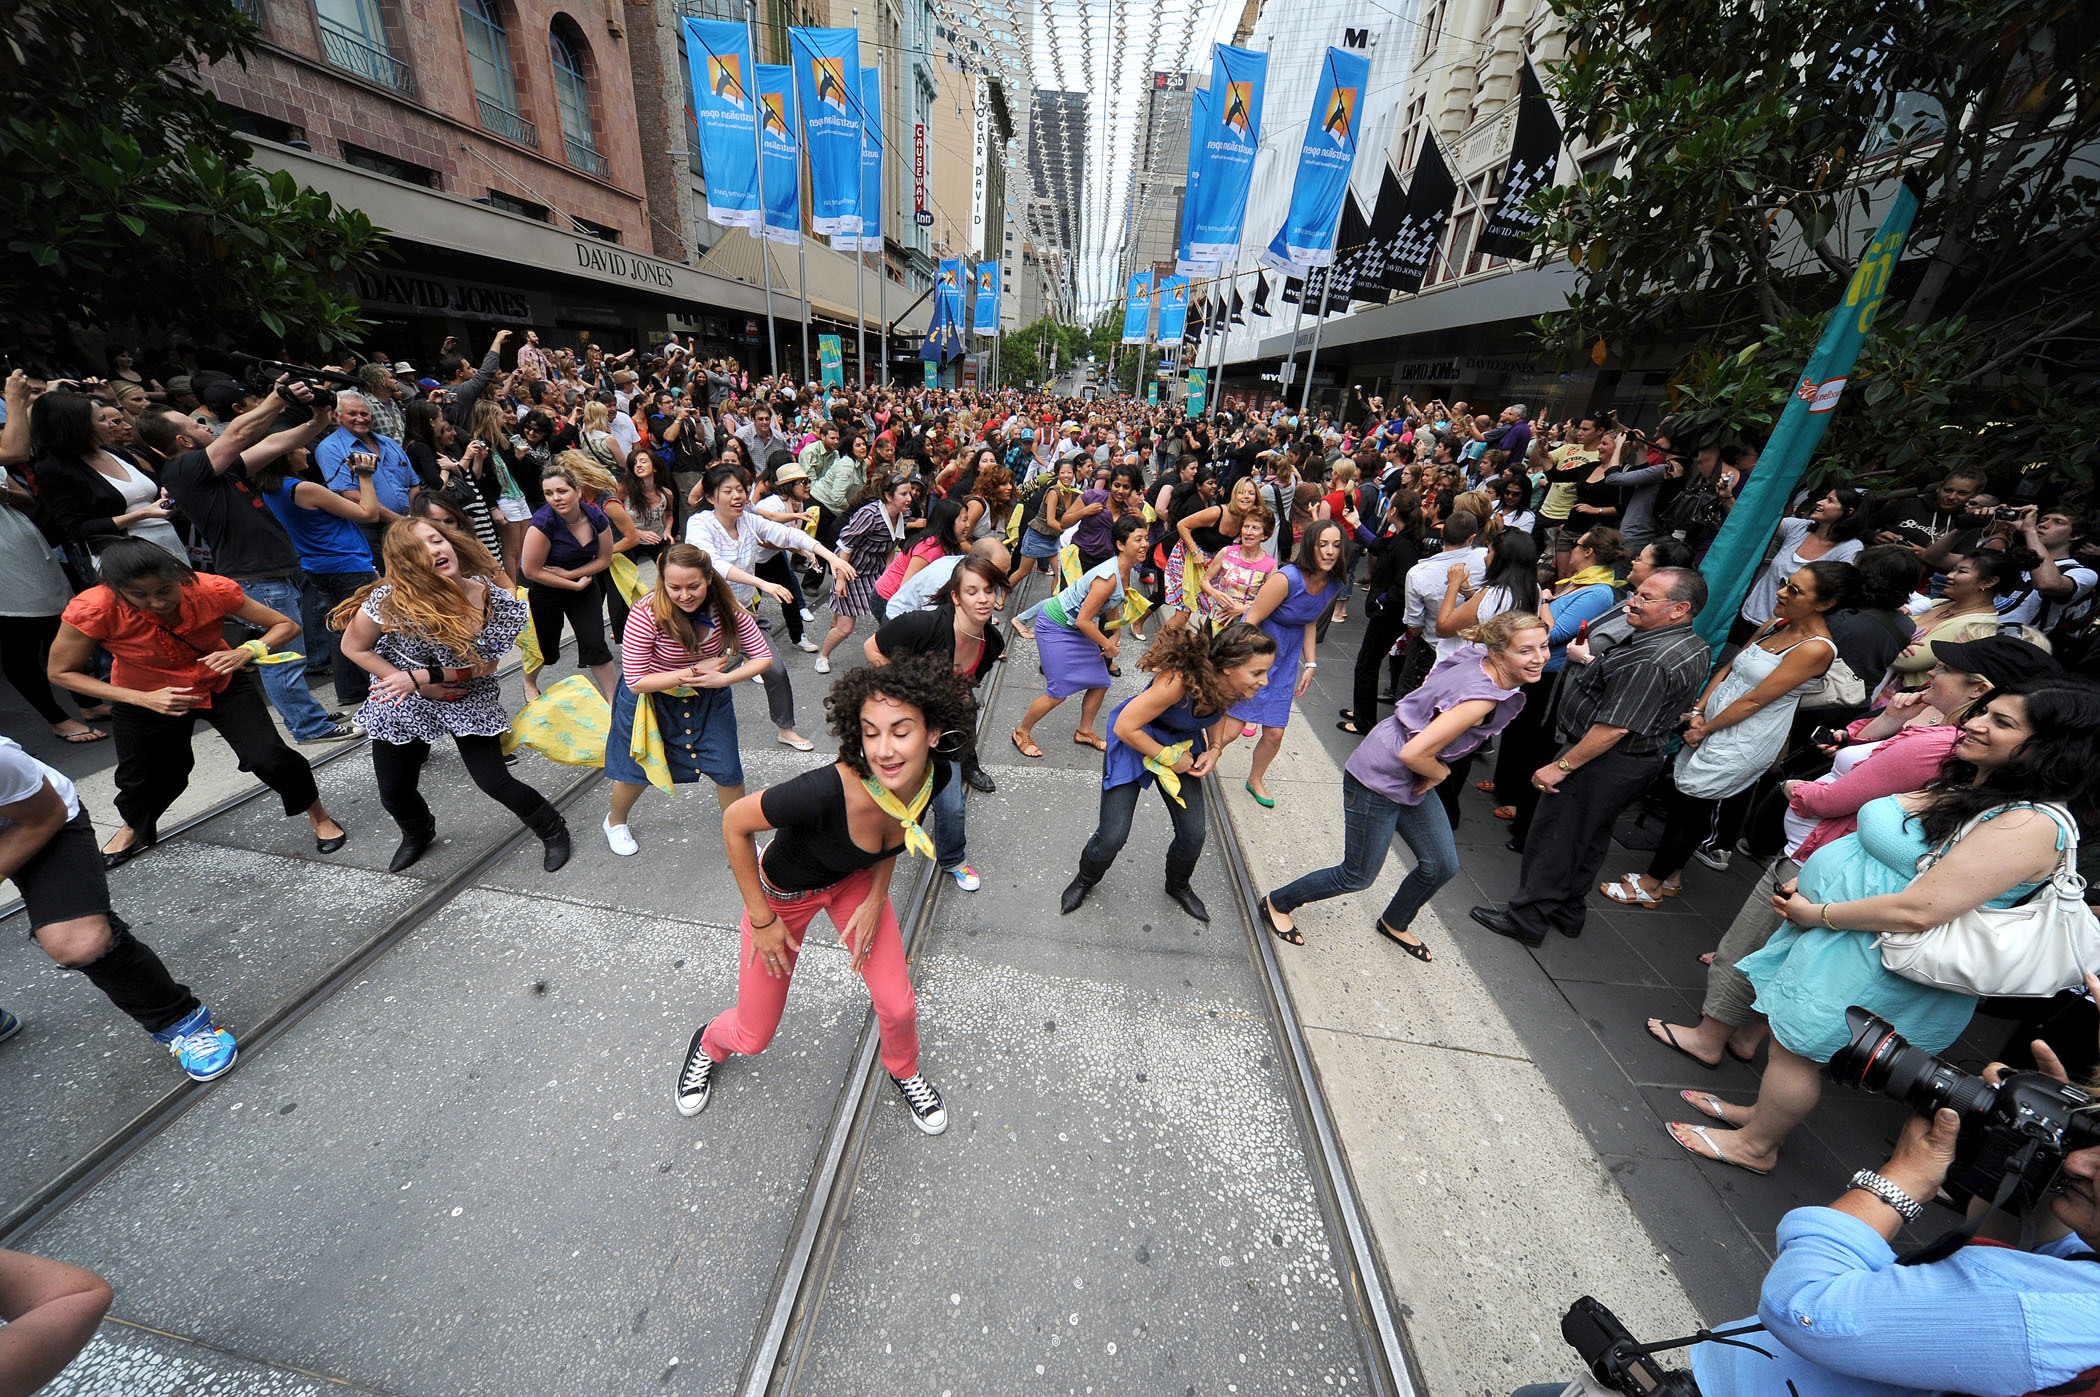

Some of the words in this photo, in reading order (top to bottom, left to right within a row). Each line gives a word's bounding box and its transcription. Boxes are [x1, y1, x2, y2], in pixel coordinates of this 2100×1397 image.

[1343, 27, 1369, 49] M
[976, 94, 985, 157] ROGER
[916, 127, 924, 205] CAUSEWAY
[974, 167, 983, 225] DAVID
[916, 213, 931, 224] Inn
[1488, 224, 1512, 237] DAVID
[575, 243, 628, 277] DAVID
[630, 257, 674, 288] JONES
[1402, 267, 1423, 278] JONES
[352, 271, 449, 308] DAVID
[452, 286, 529, 318] JONES
[1332, 292, 1349, 302] JONES
[1401, 364, 1428, 380] DAVID
[1466, 359, 1499, 370] DAVID
[1501, 361, 1535, 372] JONES
